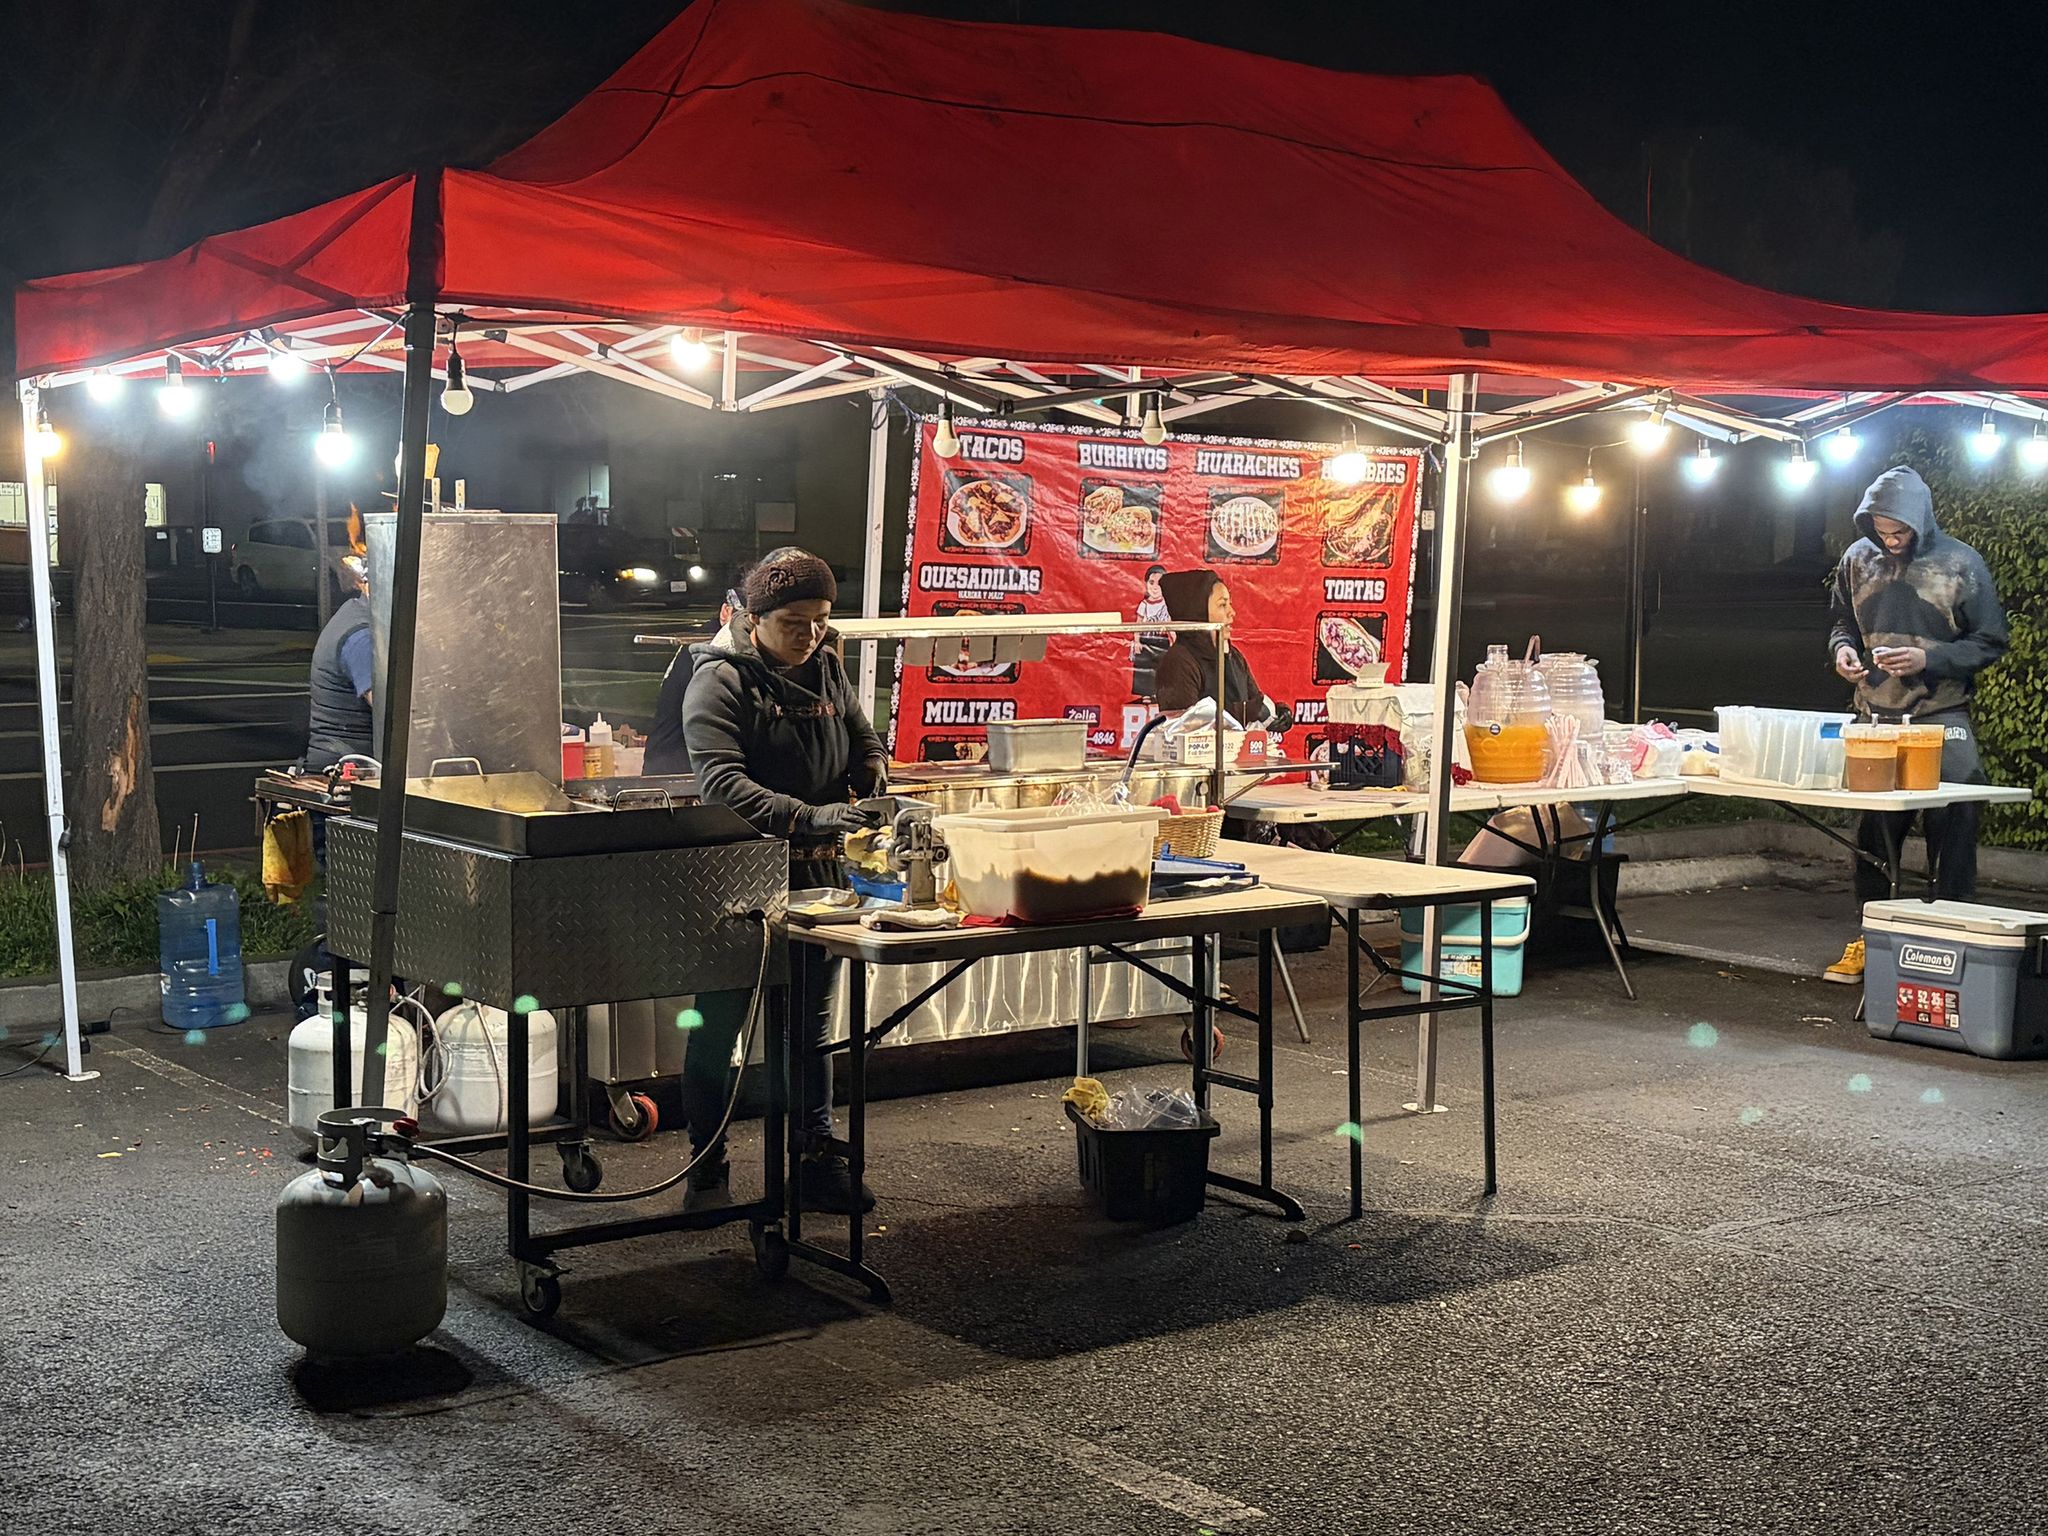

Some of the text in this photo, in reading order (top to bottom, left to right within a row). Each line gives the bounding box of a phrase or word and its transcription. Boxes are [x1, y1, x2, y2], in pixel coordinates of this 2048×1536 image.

[959, 434, 1024, 461] TACOS
[1078, 443, 1168, 471] BURRITOS
[1196, 451, 1301, 478] HUARACHES
[1321, 457, 1406, 484] ABRES
[920, 567, 1041, 591] QUESADILLAS
[1324, 579, 1386, 601] TORTAS
[924, 700, 1016, 724] MULITAS
[1068, 708, 1096, 720] Zelle
[1905, 948, 1942, 966] Coleman
